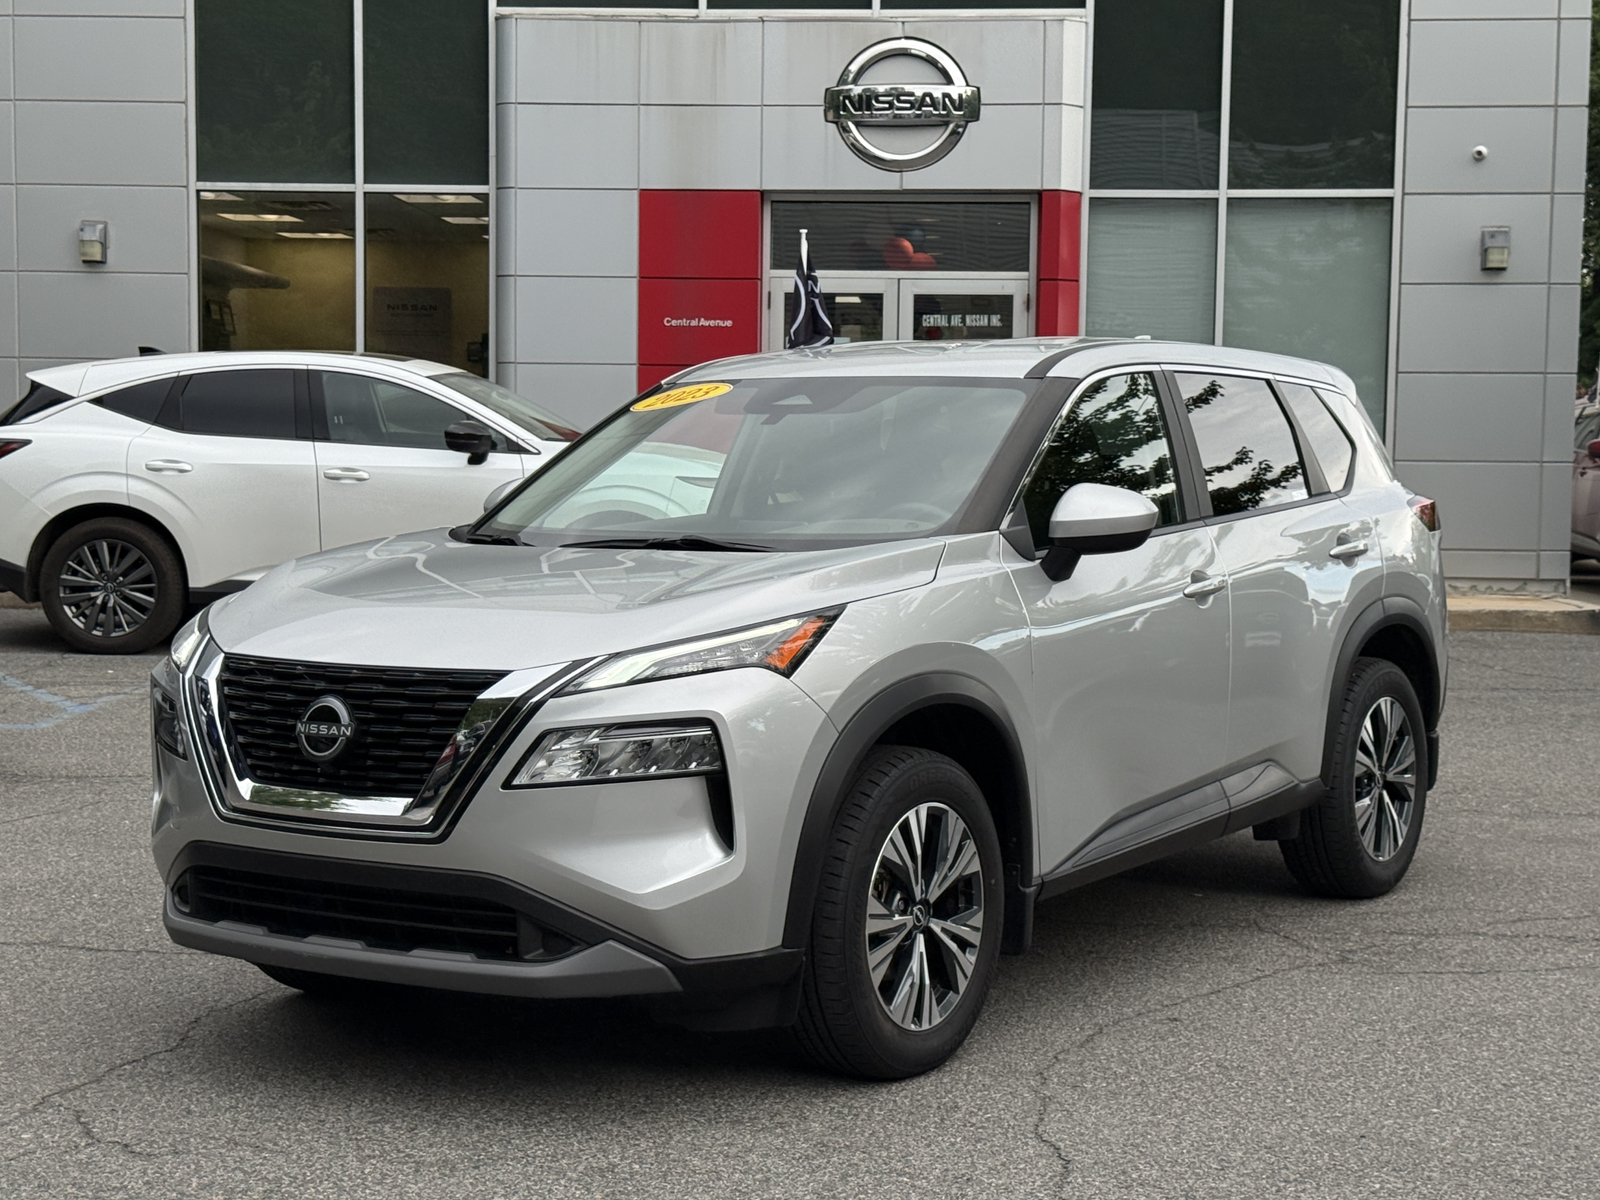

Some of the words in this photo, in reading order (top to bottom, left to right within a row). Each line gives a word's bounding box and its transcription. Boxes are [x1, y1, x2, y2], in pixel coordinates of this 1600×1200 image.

[839, 91, 965, 114] NISSAN
[663, 317, 699, 327] Central
[699, 317, 733, 327] Avenue
[922, 314, 949, 327] CENTRAL
[965, 314, 989, 327] NISSAN
[642, 385, 721, 409] 2023
[296, 723, 351, 736] NISSAN
